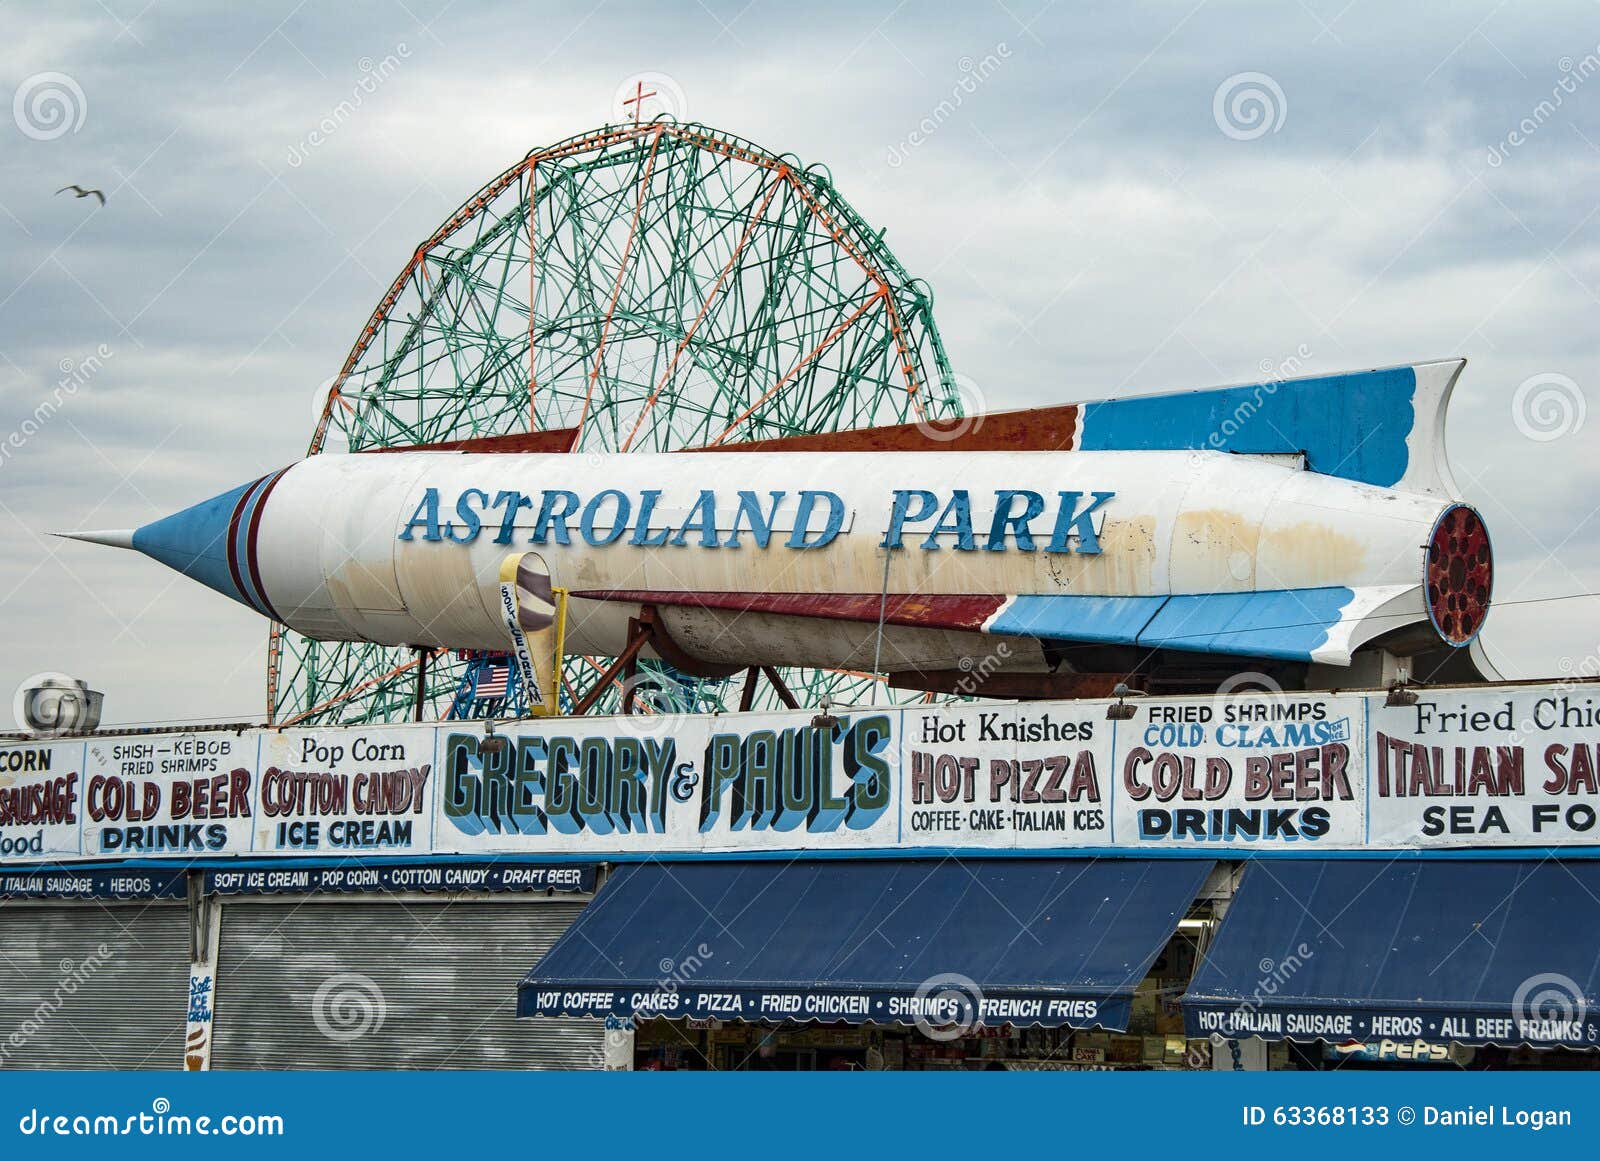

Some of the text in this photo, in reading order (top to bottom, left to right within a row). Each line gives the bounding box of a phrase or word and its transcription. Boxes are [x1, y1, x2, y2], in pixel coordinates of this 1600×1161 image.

[398, 487, 1116, 555] ASTROLAND PARK
[518, 650, 542, 703] CREAM
[921, 713, 1093, 743] Hot Knishes
[1149, 703, 1326, 724] FRIED SHRIMPS
[1414, 701, 1515, 735] Fried
[1144, 720, 1330, 749] COLD CLAMS
[113, 745, 154, 760] SHISH
[121, 758, 218, 775] FRIED SHRIMPS
[301, 737, 405, 768] Pop Corn
[1377, 731, 1600, 797] ITALIAN SA
[443, 714, 892, 836] GREGORY & PAUL'S
[911, 750, 1101, 804] HOT PIZZA
[1124, 743, 1354, 801] COLD BEER
[87, 768, 251, 823] COLD BEER
[261, 764, 431, 817] COTTON CANDY
[278, 820, 412, 848] ICE CREAM
[911, 809, 1104, 831] COFFEE CAKE ITALIAN ICES
[1138, 806, 1330, 841] DRINKS
[1421, 804, 1597, 837] SEA FO
[0, 829, 43, 853] ood
[102, 823, 228, 850] DRINKS
[5, 877, 43, 892] ITALIAN
[47, 878, 93, 893] SAUSAGE
[110, 877, 151, 892] HEROS
[215, 869, 581, 887] SOFT ICE CREAM POP CORN COTTON CANDY DRAFT BEER
[187, 1010, 212, 1023] CREAM
[190, 995, 208, 1010] ICE
[536, 992, 1098, 1018] HOT COFFEE CAKES PIZZA FRIED CHICKEN SHRIMPS FRENCH FRIES
[1198, 1011, 1223, 1030] HOT
[1229, 1013, 1281, 1032] ITALIAN
[1286, 1014, 1352, 1034] SAUSAGE
[1372, 1016, 1422, 1036] HEROS
[1440, 1018, 1470, 1037] ALL
[1475, 1018, 1513, 1039] BEEF
[1520, 1019, 1582, 1041] FRANKS
[1378, 1039, 1450, 1060] PEPS
